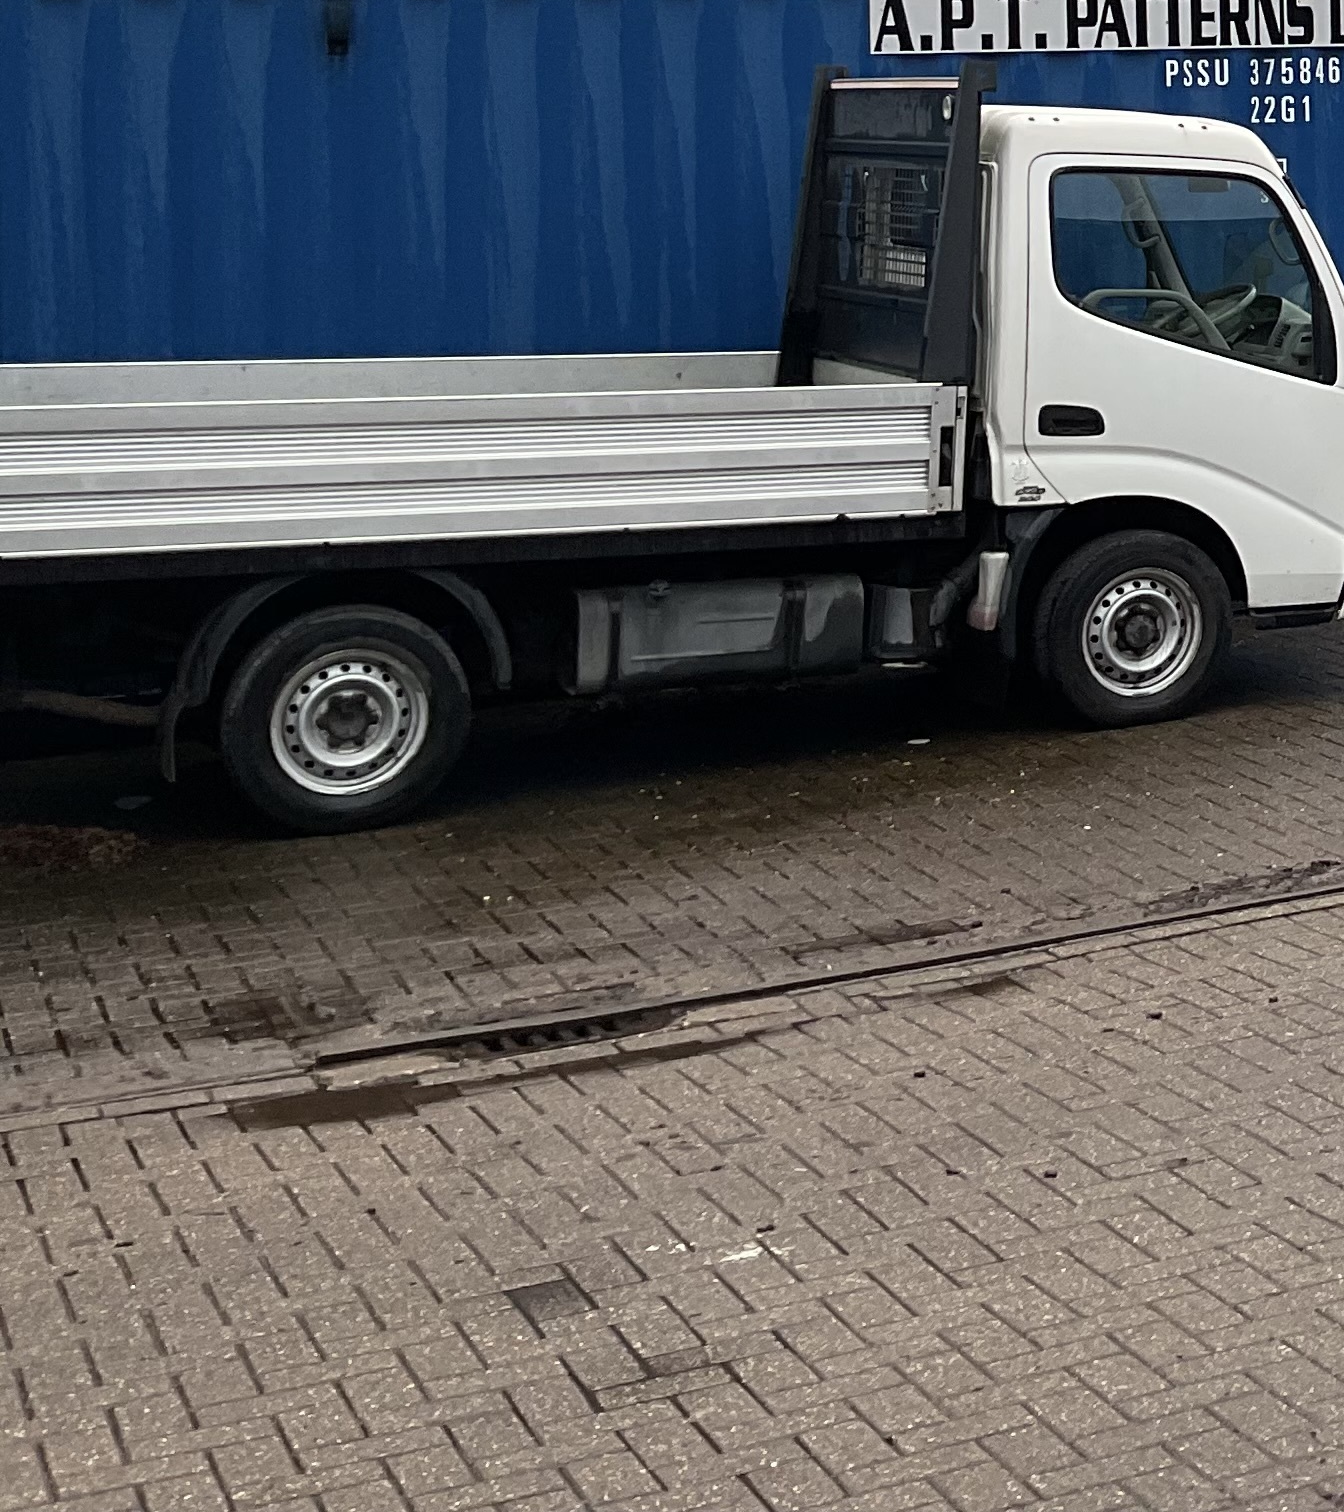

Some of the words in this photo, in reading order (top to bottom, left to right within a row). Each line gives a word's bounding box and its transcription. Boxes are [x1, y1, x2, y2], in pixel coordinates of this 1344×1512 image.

[1165, 58, 1230, 88] PSSU
[1249, 56, 1341, 86] 375846
[1250, 95, 1311, 124] 22G1
